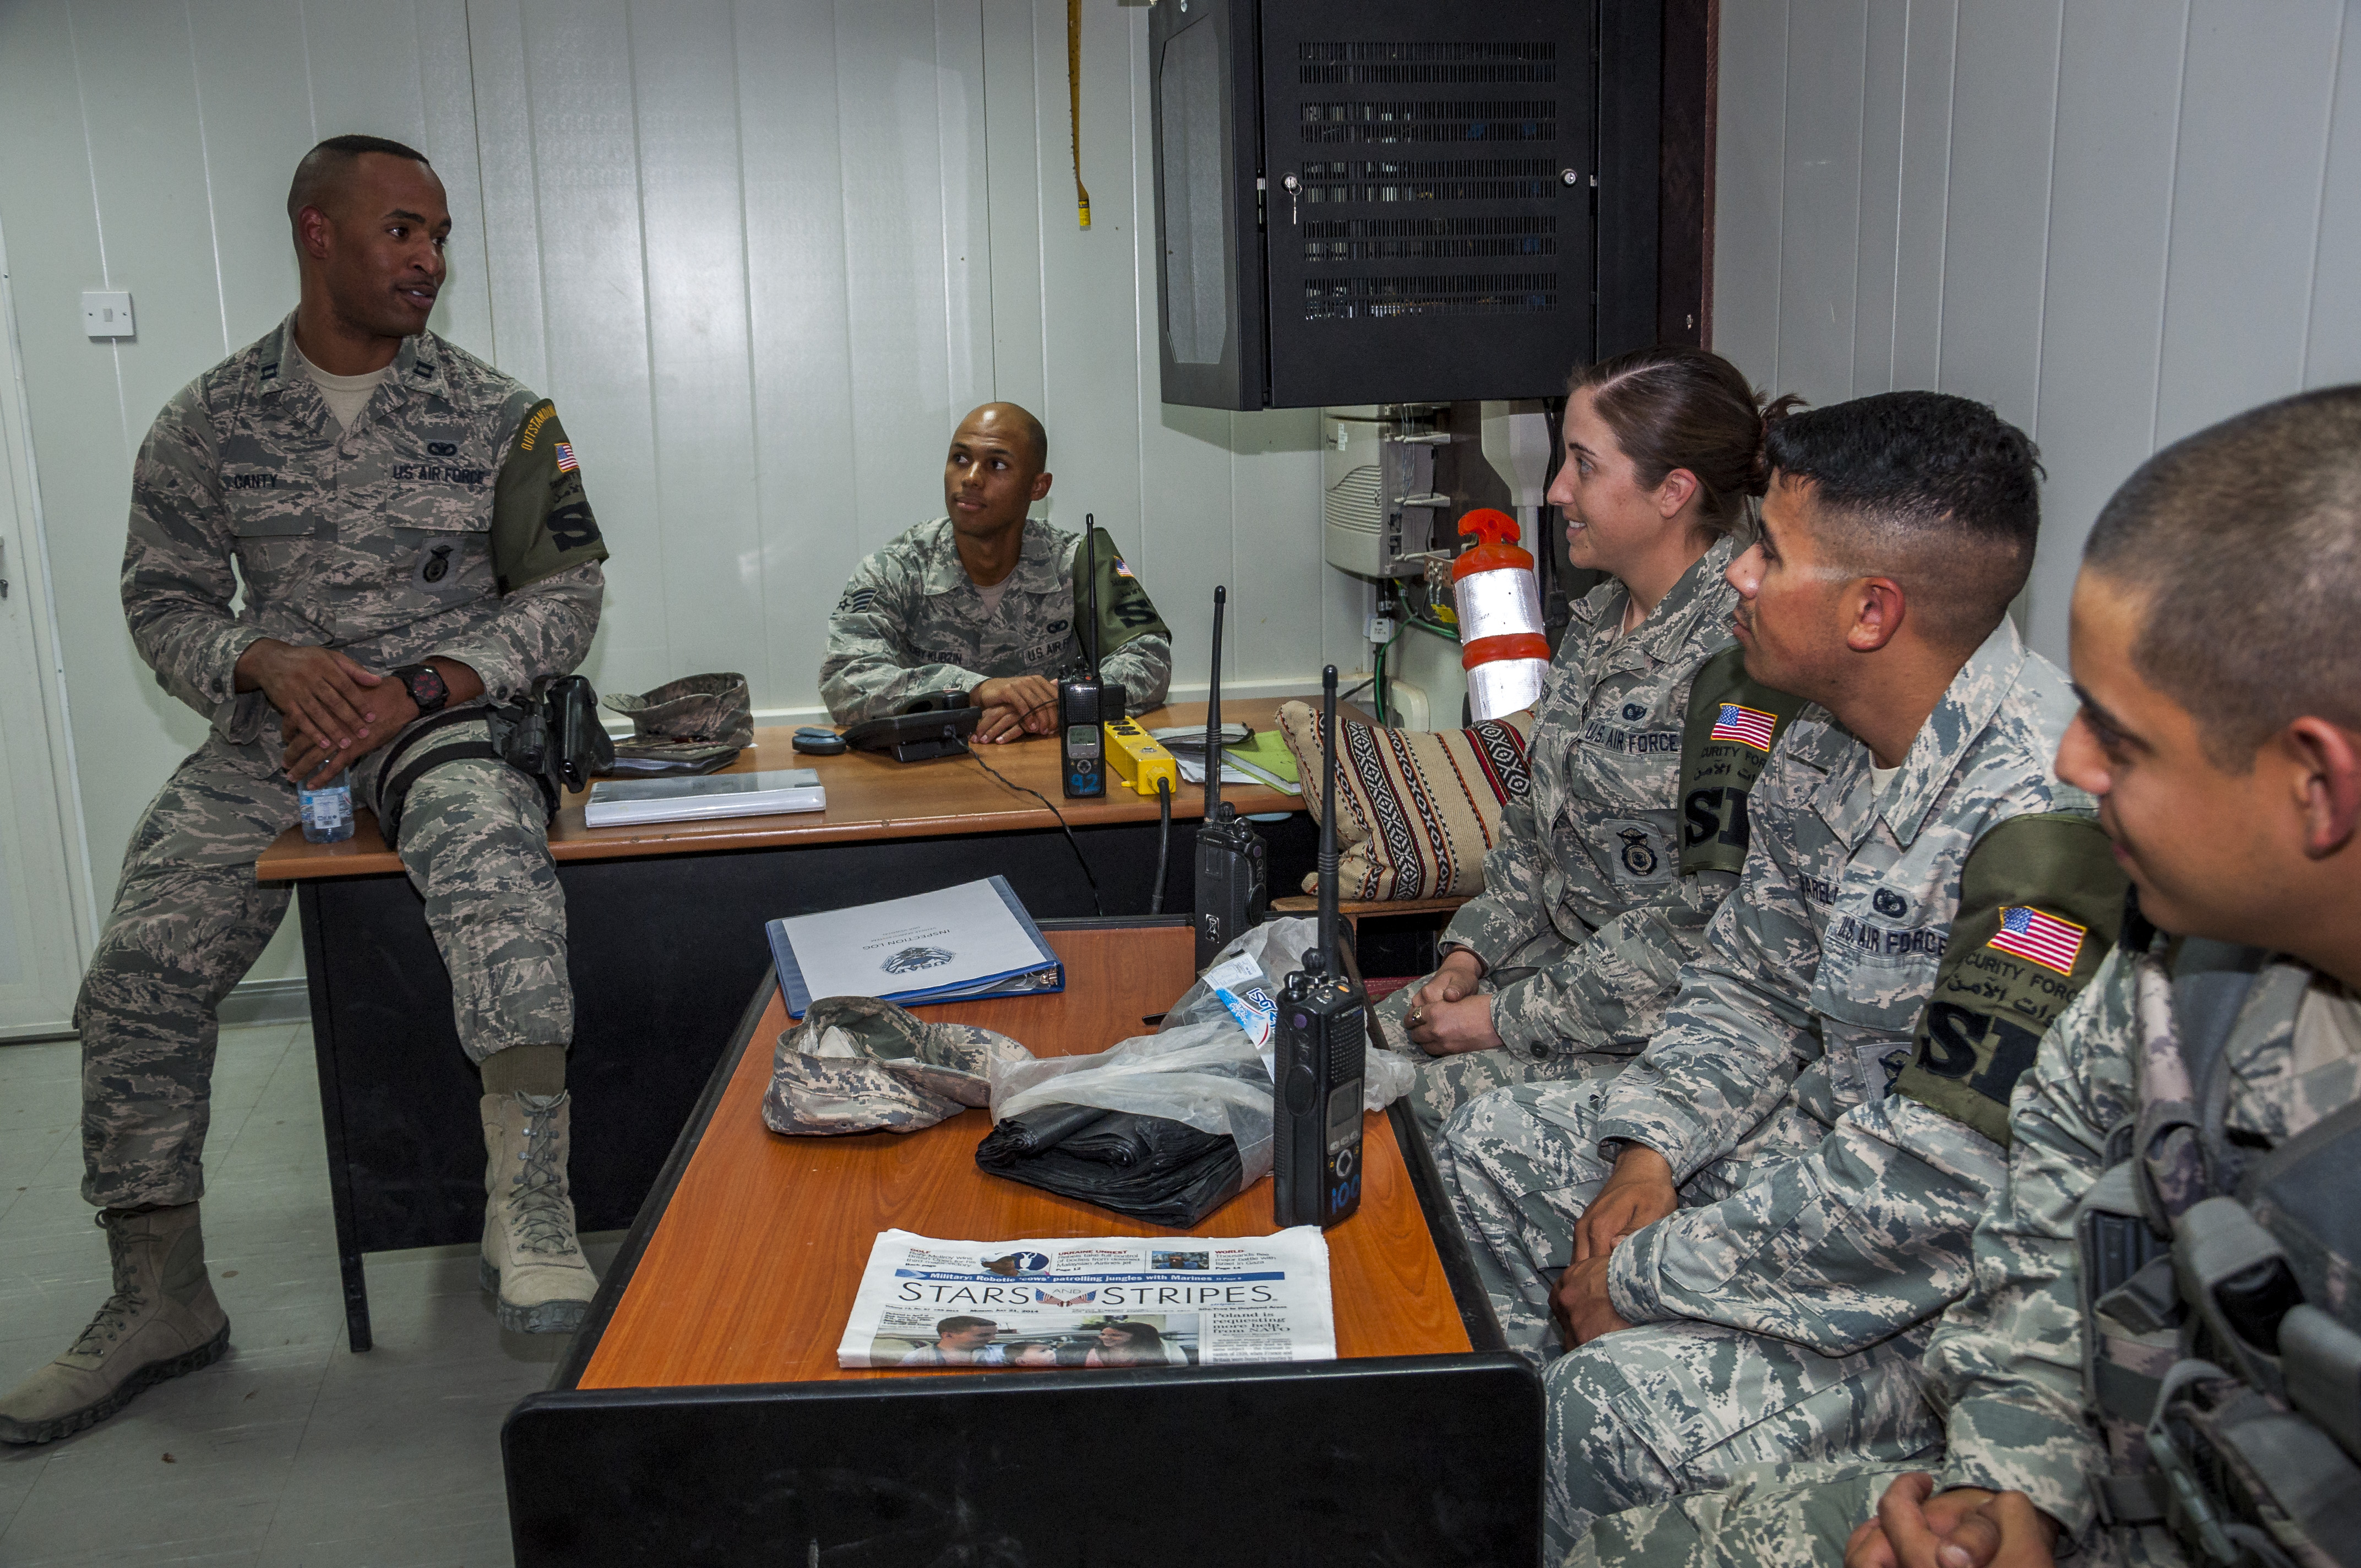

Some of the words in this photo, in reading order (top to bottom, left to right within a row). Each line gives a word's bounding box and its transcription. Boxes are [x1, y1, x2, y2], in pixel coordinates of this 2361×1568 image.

[418, 466, 440, 481] AIR
[445, 467, 485, 484] FORCE
[547, 501, 600, 552] S
[1114, 598, 1158, 629] S
[1585, 722, 1605, 743] U.S.
[1606, 729, 1624, 751] AIR
[1629, 733, 1678, 753] FORCE
[1701, 746, 1740, 758] CURITY
[1745, 750, 1767, 769] FOR
[1071, 774, 1100, 792] 92
[888, 929, 950, 945] INSPECTION
[1858, 924, 1880, 952] AIR
[1886, 930, 1947, 956] FORCE
[1966, 952, 2025, 980] CURITY
[2030, 972, 2081, 1003] FORC
[1331, 1174, 1360, 1215] 100
[899, 1282, 1030, 1305] STARS
[1102, 1285, 1272, 1305] STRIPES
